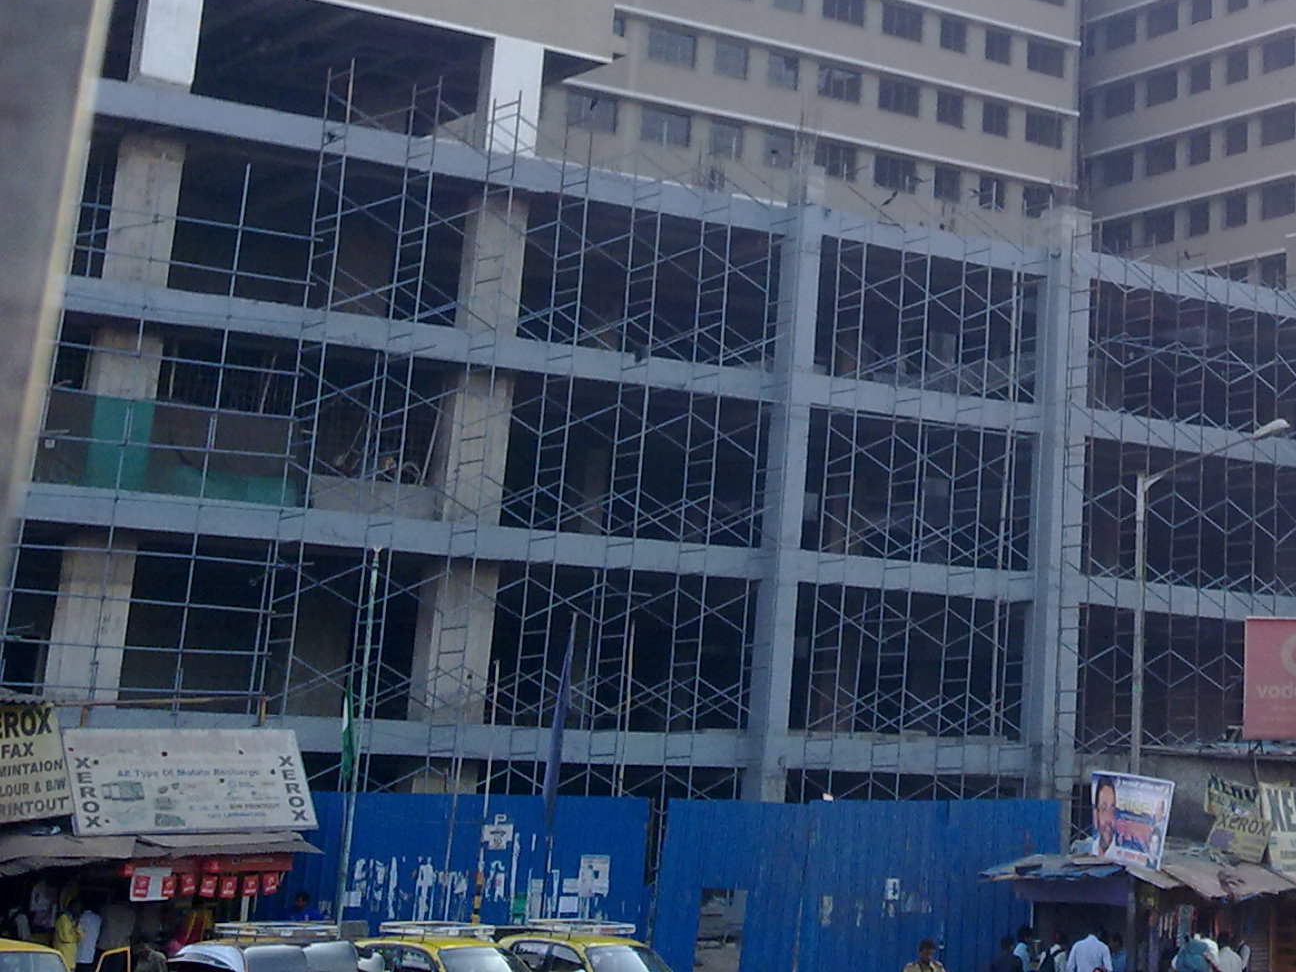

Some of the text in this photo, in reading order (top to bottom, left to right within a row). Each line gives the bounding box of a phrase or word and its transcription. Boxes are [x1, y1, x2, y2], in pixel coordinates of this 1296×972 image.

[1, 742, 34, 759] FAX
[75, 757, 102, 828] XEROX
[279, 755, 308, 822] XEROX
[1217, 812, 1269, 836] XEROX
